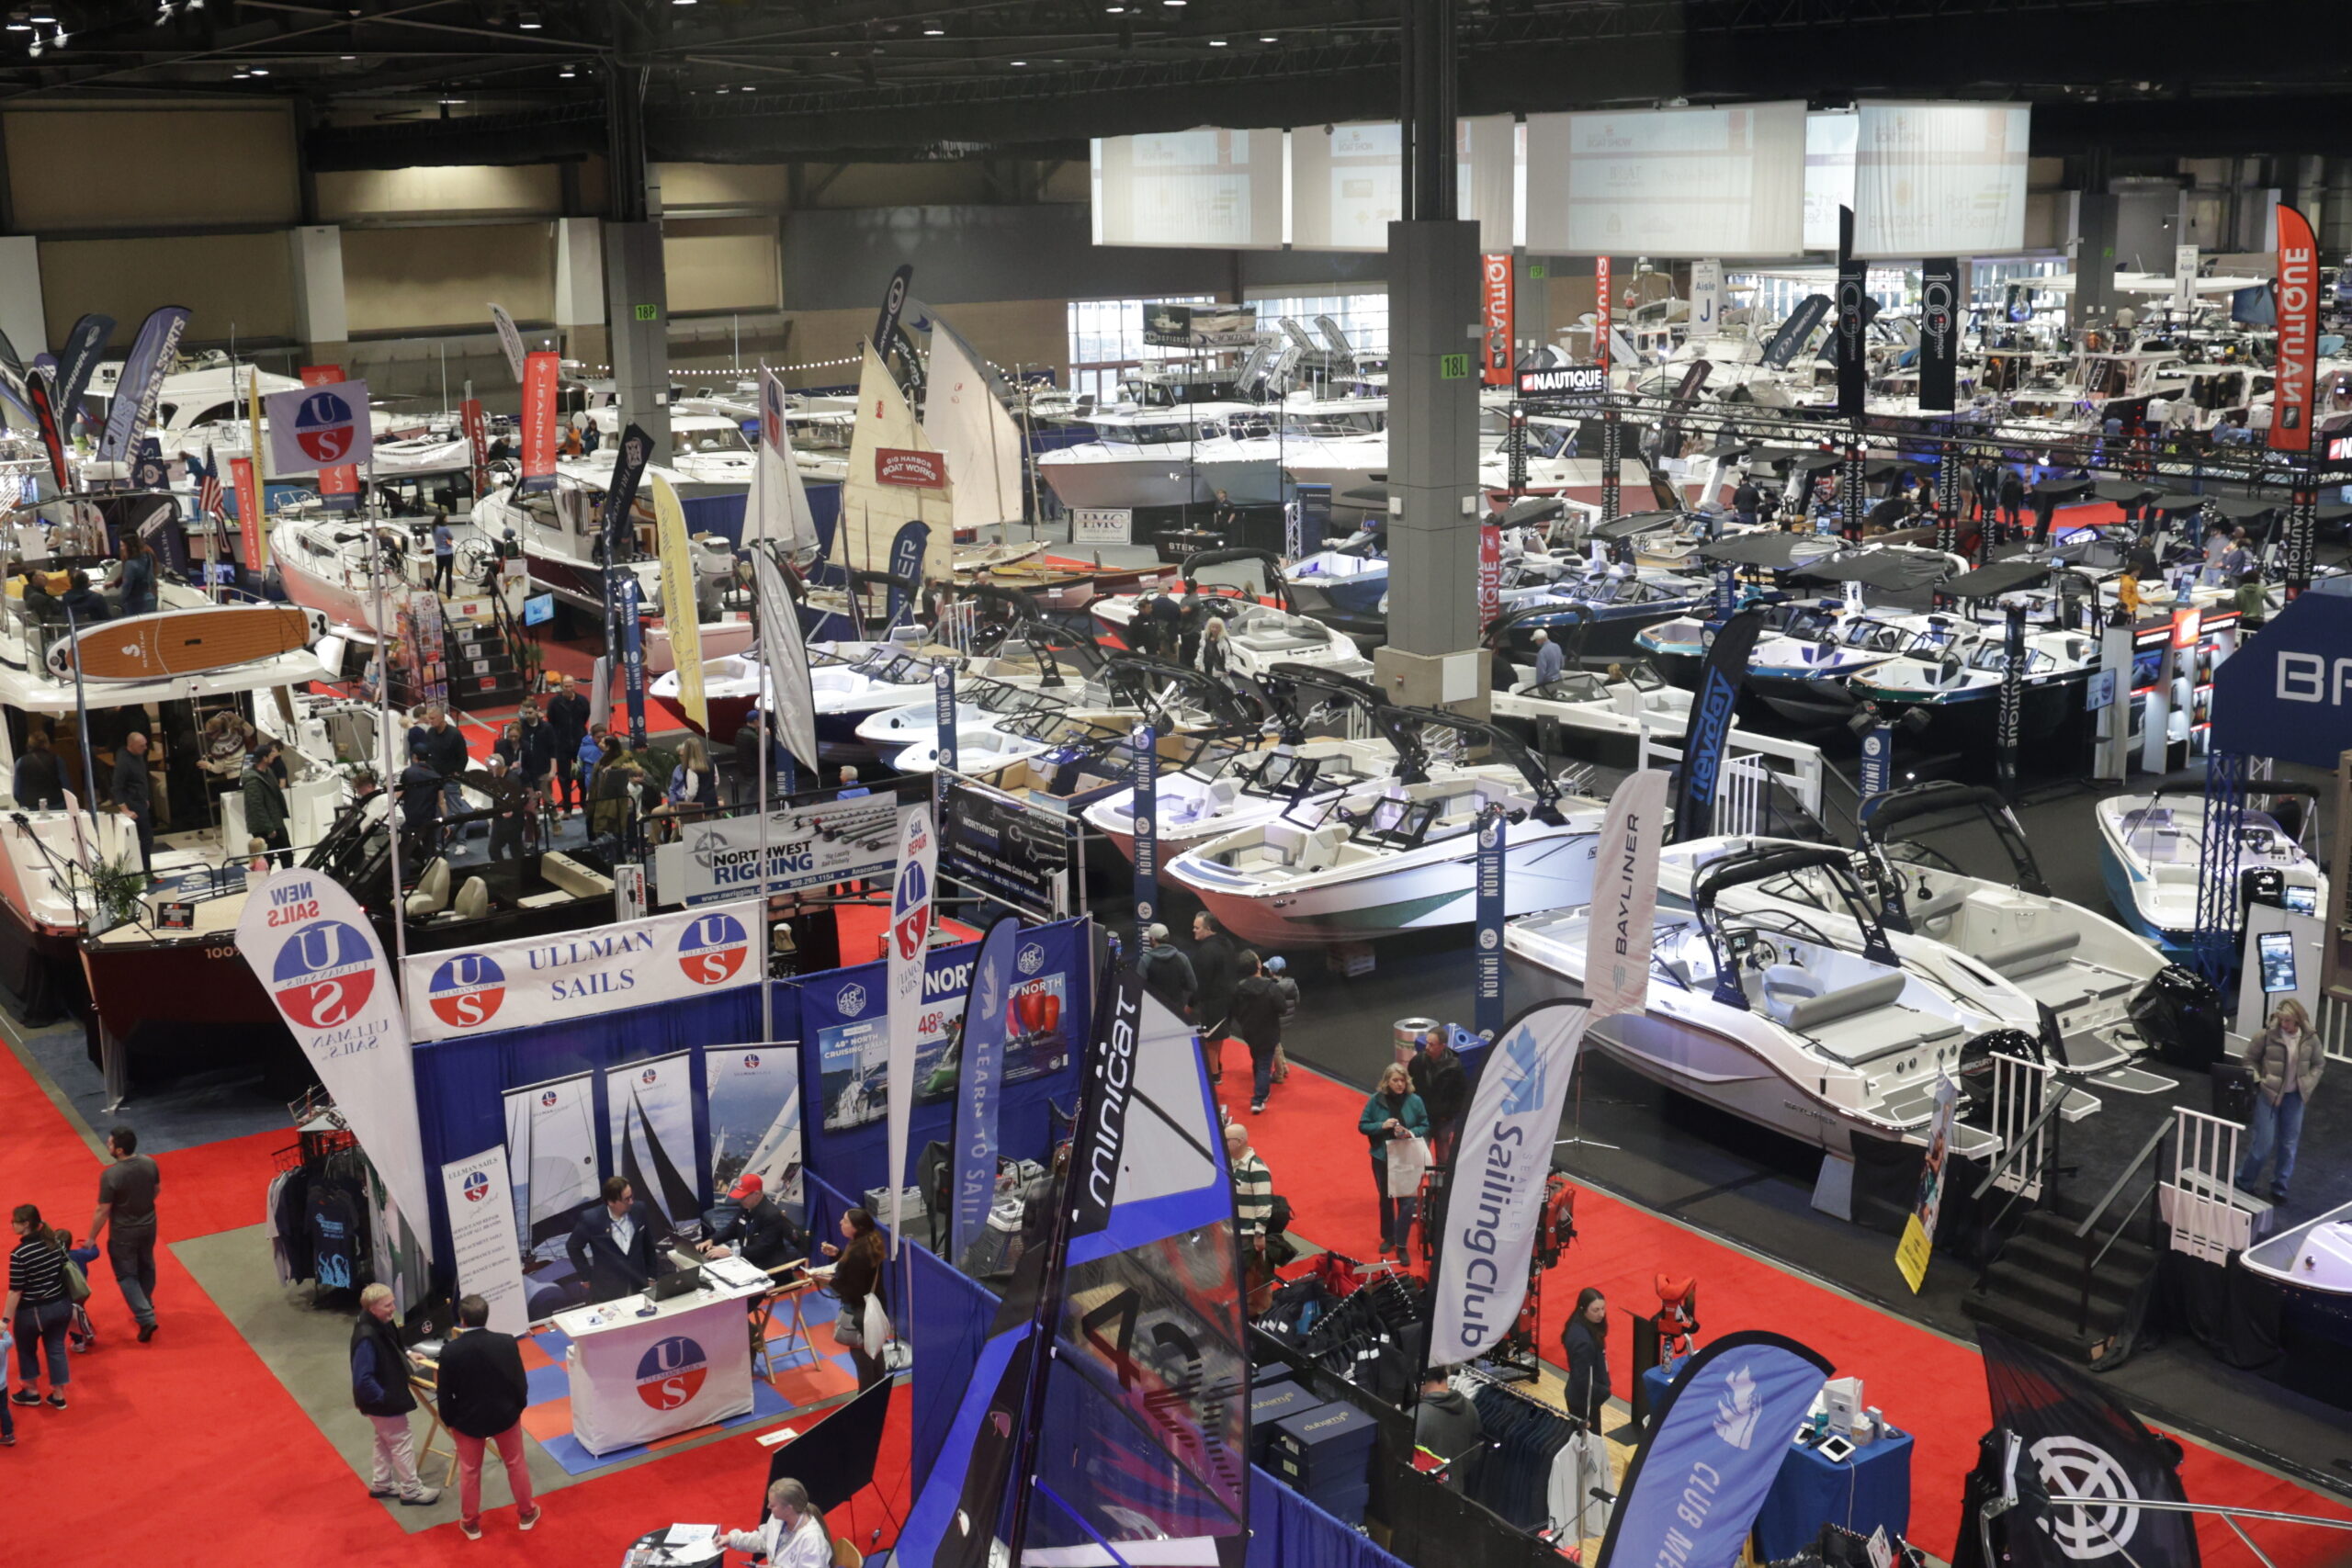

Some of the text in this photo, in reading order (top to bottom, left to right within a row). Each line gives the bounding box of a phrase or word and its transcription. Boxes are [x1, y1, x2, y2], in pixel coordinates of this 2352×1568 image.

[1695, 280, 1716, 291] Aisle
[638, 306, 654, 319] 18P
[1700, 299, 1711, 321] J
[1444, 355, 1465, 378] 18L
[1534, 370, 1602, 390] NAUTIQUE
[534, 377, 547, 474] JEANNEAU
[882, 463, 903, 476] BOAT
[906, 463, 937, 481] WORKS
[900, 456, 932, 468] HARBOR
[1844, 461, 1852, 524] NAUTIQUE
[1855, 461, 1864, 525] NAUTIQUE
[1082, 513, 1124, 529] IMC
[1169, 542, 1195, 552] STEK
[2288, 504, 2304, 581] NAUTIQUE
[2303, 505, 2316, 581] NAUTIQUE
[1719, 584, 1730, 607] UNION
[940, 694, 951, 725] UNION
[1996, 655, 2010, 747] NAUTIQUE
[2007, 655, 2025, 749] NAUTIQUE
[1138, 757, 1150, 791] UNION
[910, 820, 922, 838] SAIL
[963, 817, 1000, 838] NORTHWEST
[714, 840, 813, 866] NORTHWEST
[908, 834, 927, 858] REPAIR
[1139, 841, 1152, 875] UNION
[714, 853, 814, 886] RIGGING
[904, 863, 920, 907] U
[1483, 856, 1498, 897] UNION
[1615, 812, 1639, 956] BAYLINER
[635, 873, 643, 905] HARKEN
[701, 884, 772, 902] www.nwrigging.cm
[696, 916, 729, 945] U
[907, 916, 919, 958] S
[528, 930, 653, 970] ULLMAN
[448, 956, 485, 987] U
[703, 953, 728, 985] S
[1483, 957, 1498, 998] UNION
[435, 985, 471, 998] ULLMAN
[551, 969, 636, 1001] SAILS
[1022, 977, 1062, 995] NORTH
[458, 994, 484, 1027] S
[919, 1011, 944, 1034] 48°
[824, 1045, 864, 1059] CRUISING
[851, 1033, 878, 1046] NORTH
[1962, 1058, 1994, 1072] MERCURY
[971, 1043, 989, 1158] LEARN TO
[1090, 984, 1136, 1208] minicat
[448, 1157, 498, 1180] ULLMAN SAILS
[469, 1173, 481, 1187] U
[472, 1189, 482, 1201] S
[1461, 1121, 1523, 1348] SailingClub
[654, 1338, 687, 1371] U
[662, 1376, 687, 1410] S
[1304, 1411, 1349, 1431] dubarry
[1678, 1461, 1720, 1529] CLUB
